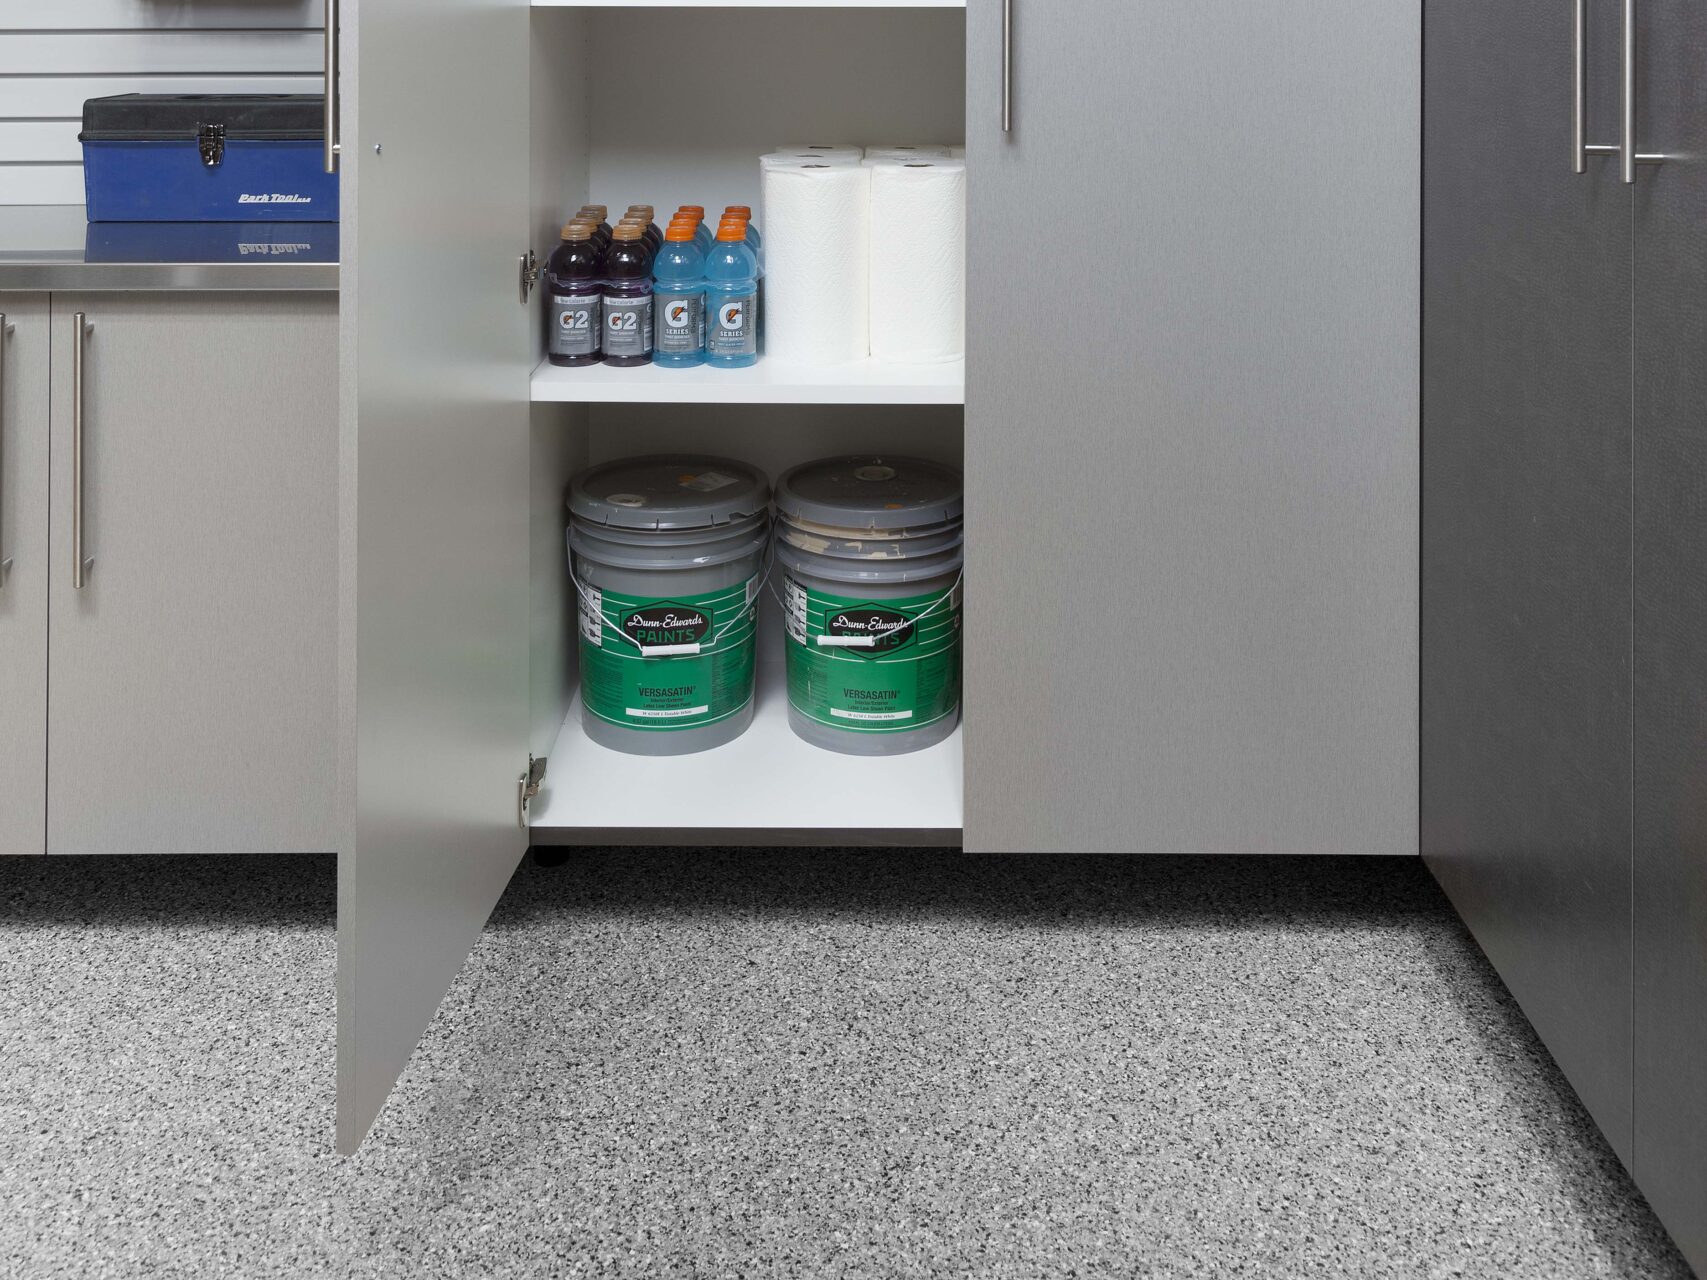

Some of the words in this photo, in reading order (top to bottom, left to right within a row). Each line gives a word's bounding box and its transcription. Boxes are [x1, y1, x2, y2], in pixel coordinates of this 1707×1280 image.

[238, 194, 270, 203] Park
[271, 194, 299, 202] Tool
[559, 310, 589, 329] G2
[608, 312, 637, 330] G2
[664, 300, 688, 328] G
[719, 302, 743, 330] G
[627, 614, 704, 628] Dunn-Edwards
[636, 629, 696, 642] PAINTS
